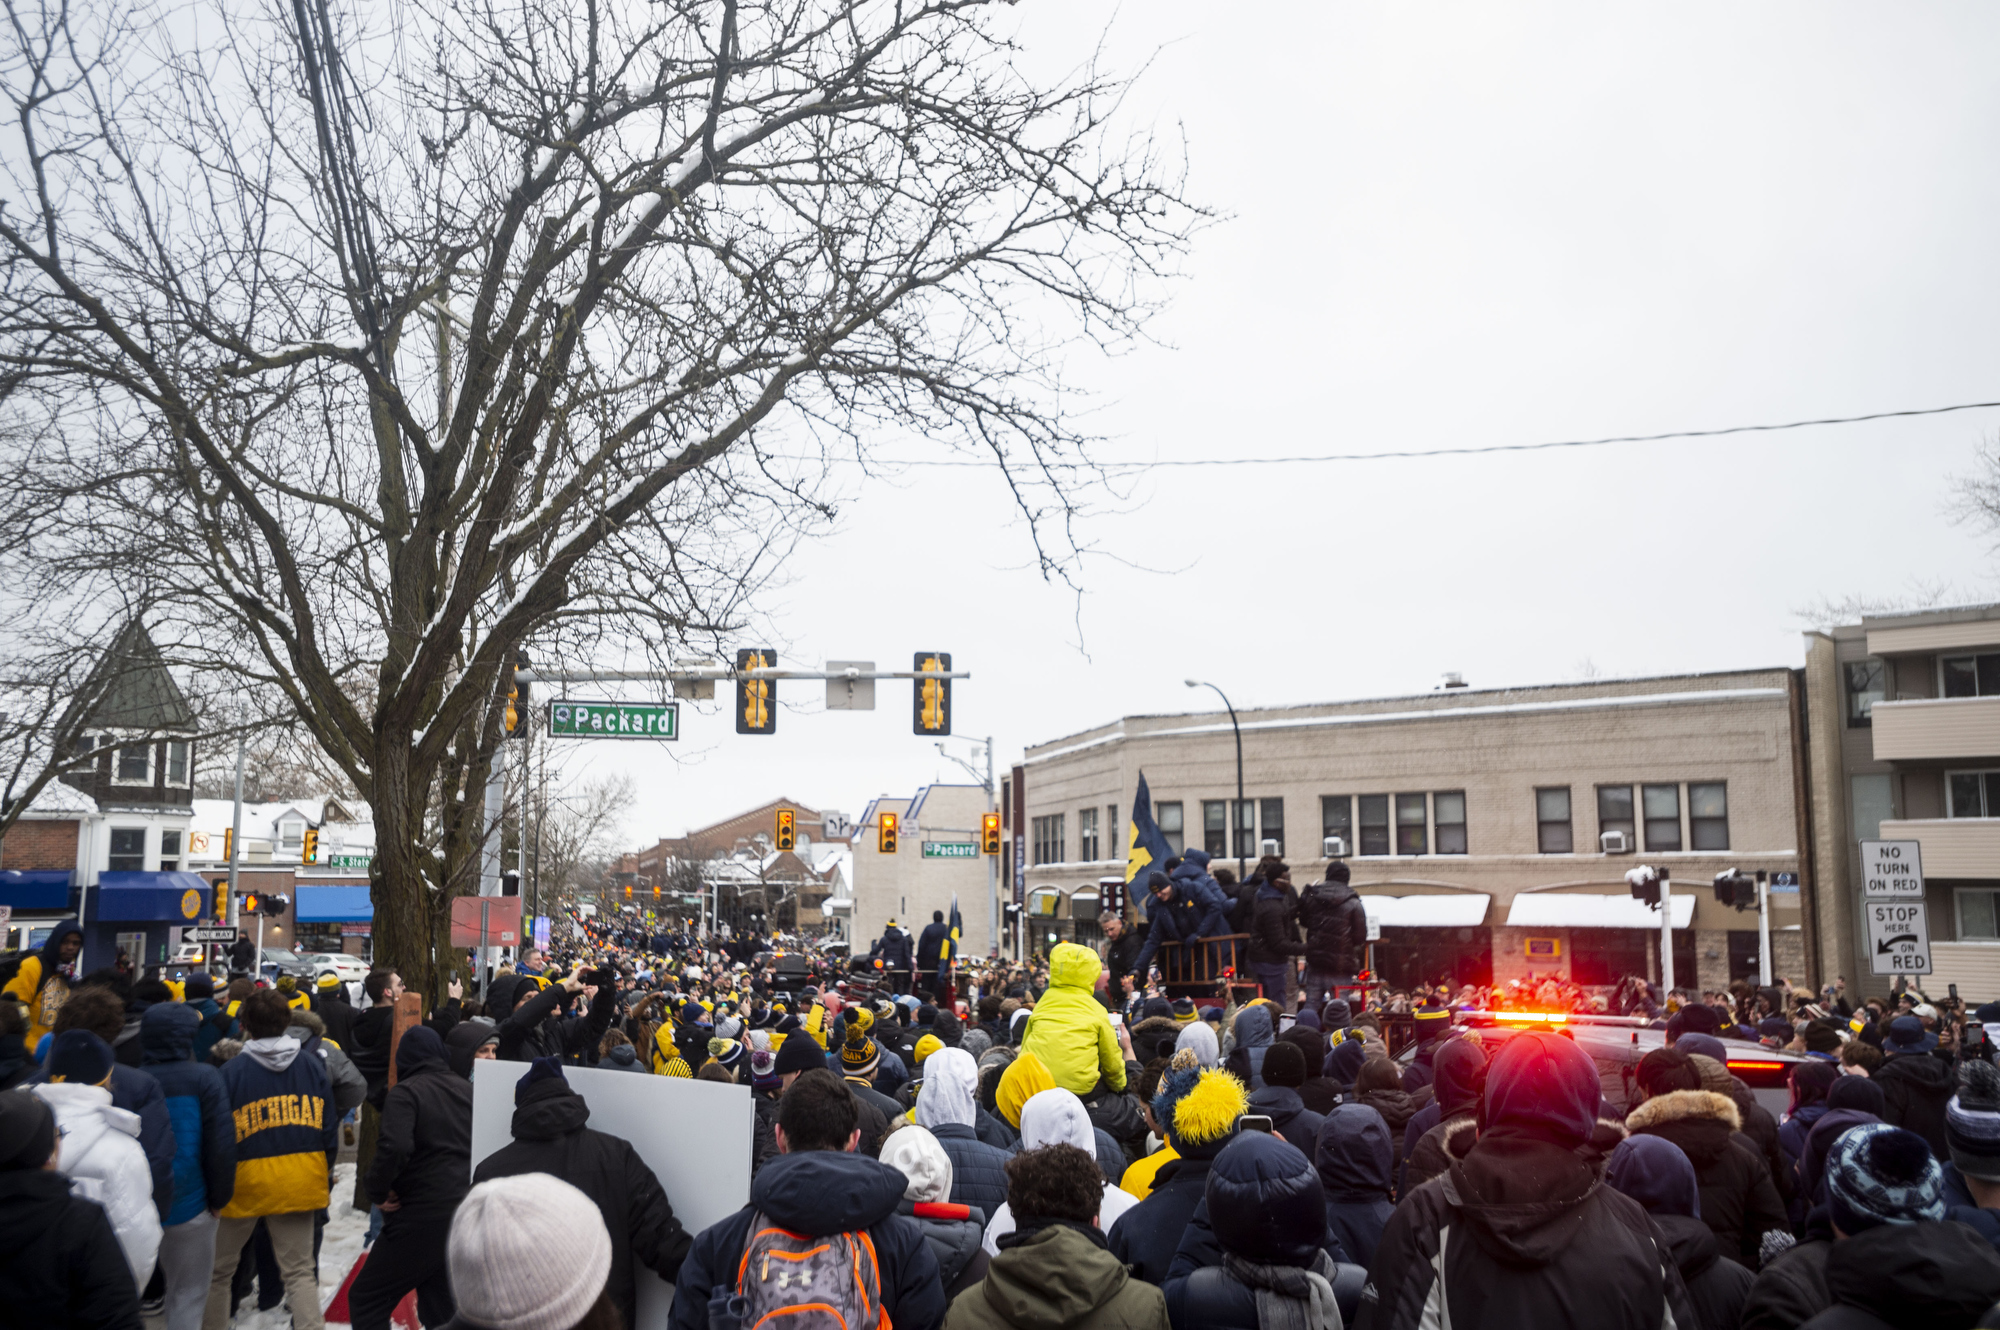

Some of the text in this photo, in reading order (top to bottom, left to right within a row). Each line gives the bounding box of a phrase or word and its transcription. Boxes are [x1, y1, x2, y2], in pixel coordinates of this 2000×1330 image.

[574, 706, 670, 733] Packard
[933, 843, 977, 856] Packard
[1880, 846, 1901, 859] NO
[339, 856, 370, 867] S. State
[1874, 862, 1909, 875] TURN
[1869, 879, 1918, 891] ON RED
[1875, 907, 1918, 922] STOP
[196, 930, 231, 939] ONE WAY
[1884, 923, 1911, 933] HERE
[1900, 943, 1915, 953] ON
[1892, 955, 1925, 970] RED
[232, 1093, 325, 1144] MICHIGAN
